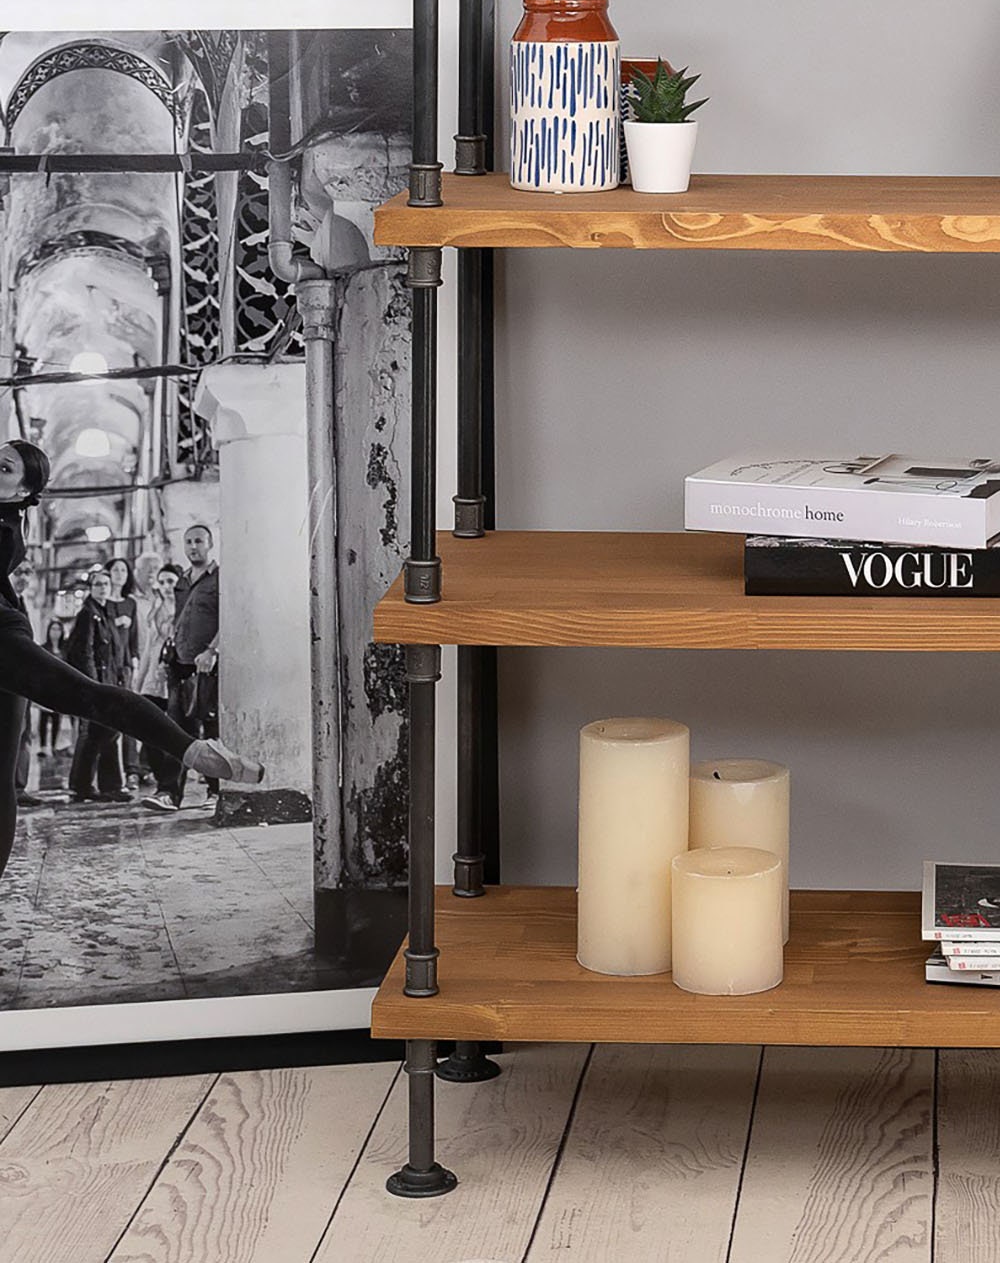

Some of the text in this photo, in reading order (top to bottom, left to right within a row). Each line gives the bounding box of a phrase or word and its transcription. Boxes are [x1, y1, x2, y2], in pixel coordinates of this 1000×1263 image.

[710, 502, 844, 523] monochrome home
[839, 552, 973, 588] VOGUE
